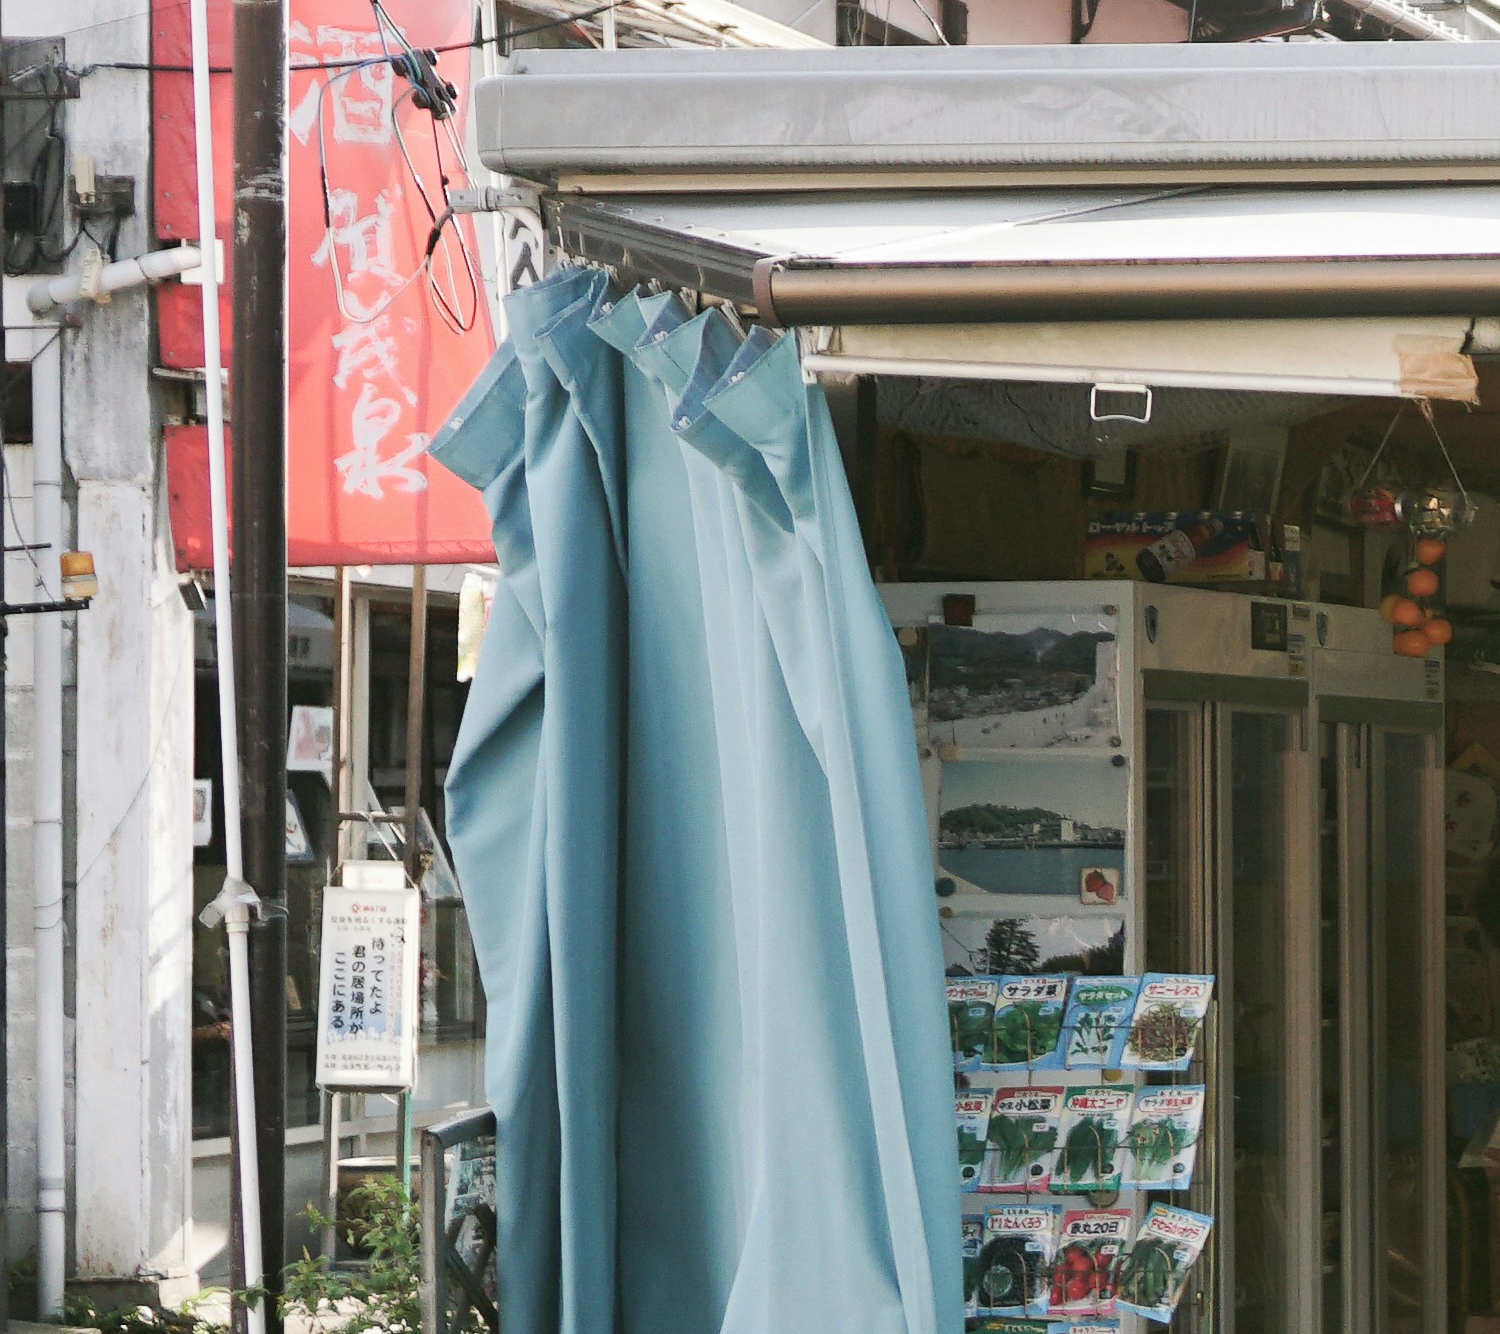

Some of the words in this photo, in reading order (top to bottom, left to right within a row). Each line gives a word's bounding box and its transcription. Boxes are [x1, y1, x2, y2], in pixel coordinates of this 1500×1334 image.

[331, 952, 346, 1029] ここにある
[370, 937, 385, 1015] 待ってたよ
[1006, 984, 1057, 998] サラダ菜
[1148, 984, 1200, 996] サニーレタス
